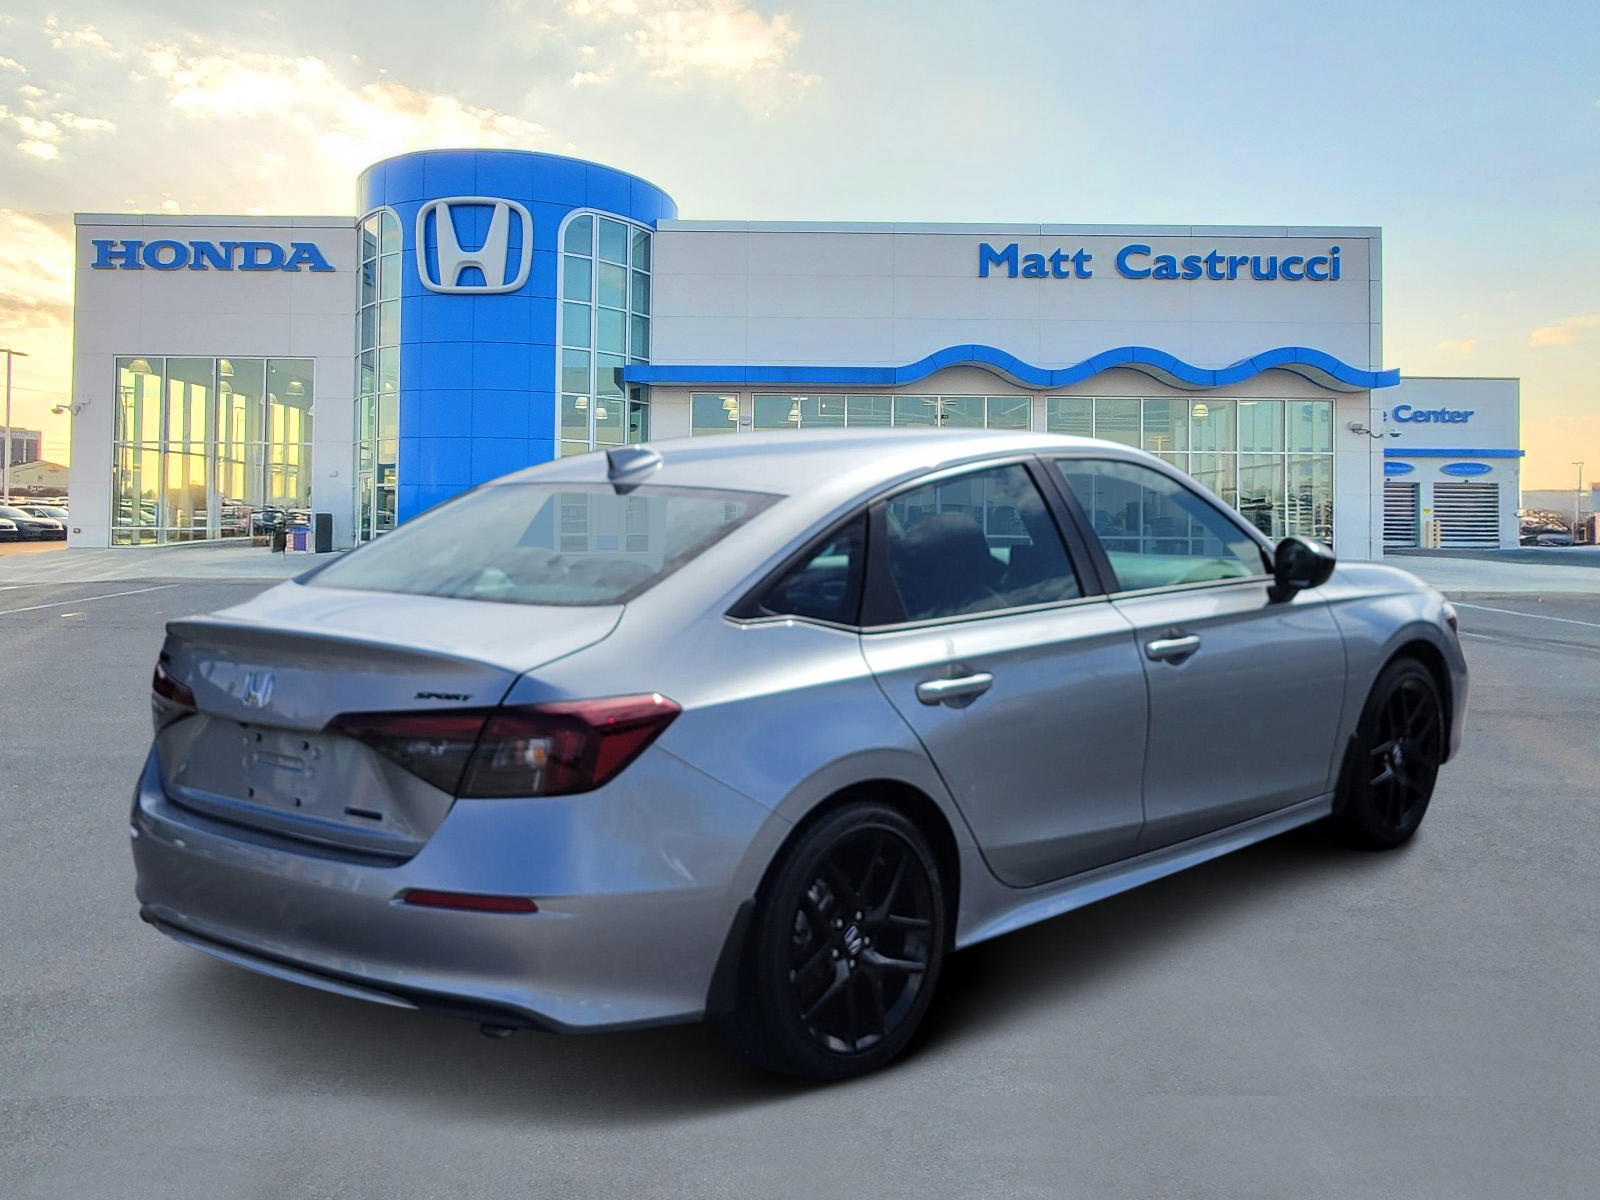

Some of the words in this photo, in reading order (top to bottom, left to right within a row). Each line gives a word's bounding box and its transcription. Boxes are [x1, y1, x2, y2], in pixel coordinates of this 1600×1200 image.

[91, 239, 336, 273] HONDA
[978, 242, 1093, 279] Matt
[1114, 244, 1342, 281] Castrucci
[1392, 404, 1474, 424] Center
[414, 691, 474, 702] SPORT
